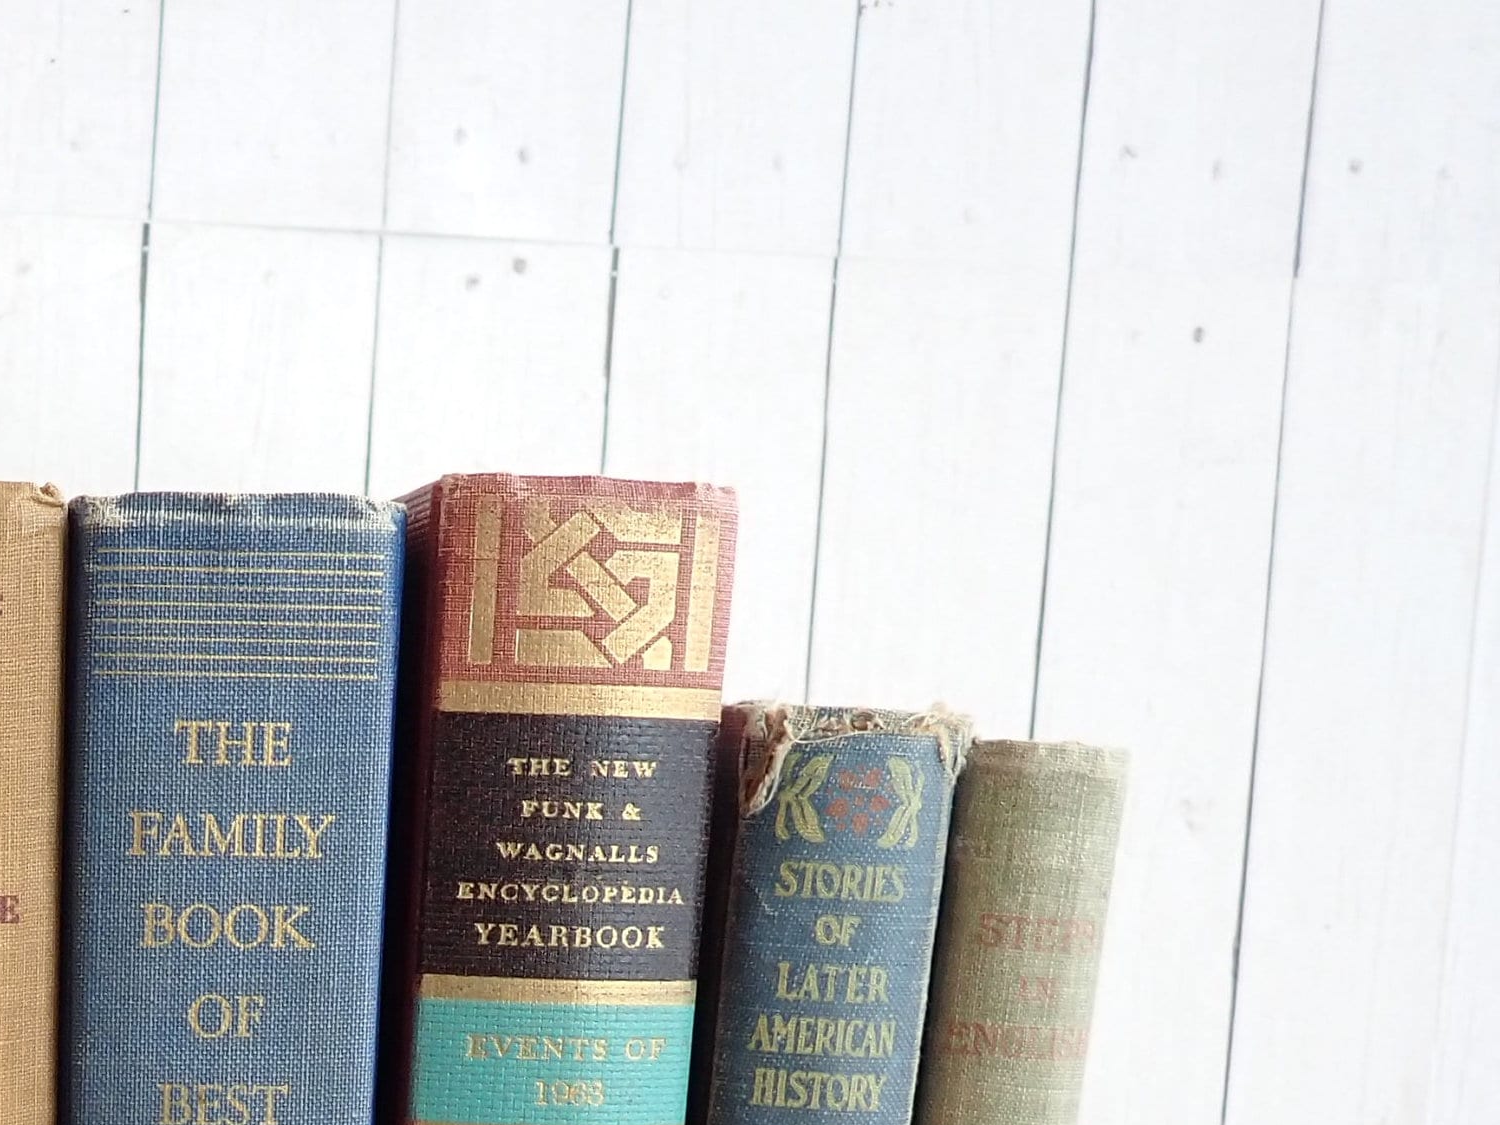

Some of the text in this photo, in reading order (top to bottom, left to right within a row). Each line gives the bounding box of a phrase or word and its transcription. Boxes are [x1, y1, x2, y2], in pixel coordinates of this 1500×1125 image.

[174, 719, 293, 767] THE
[507, 757, 657, 778] THE NEW
[521, 800, 642, 821] FUNK &
[127, 809, 336, 859] FAMILY
[496, 842, 661, 864] WAGNALLS
[456, 881, 684, 905] ENCYCLOPEDIA
[774, 860, 906, 902] STORIES
[140, 903, 316, 949] BOOK
[474, 922, 665, 948] YEARBOOK
[815, 914, 862, 947] OF
[775, 961, 890, 1003] LATER
[187, 993, 265, 1039] OF
[748, 1013, 896, 1058] AMERICAN
[466, 1034, 666, 1061] EVENTS OF
[752, 1067, 887, 1112] HISTORY
